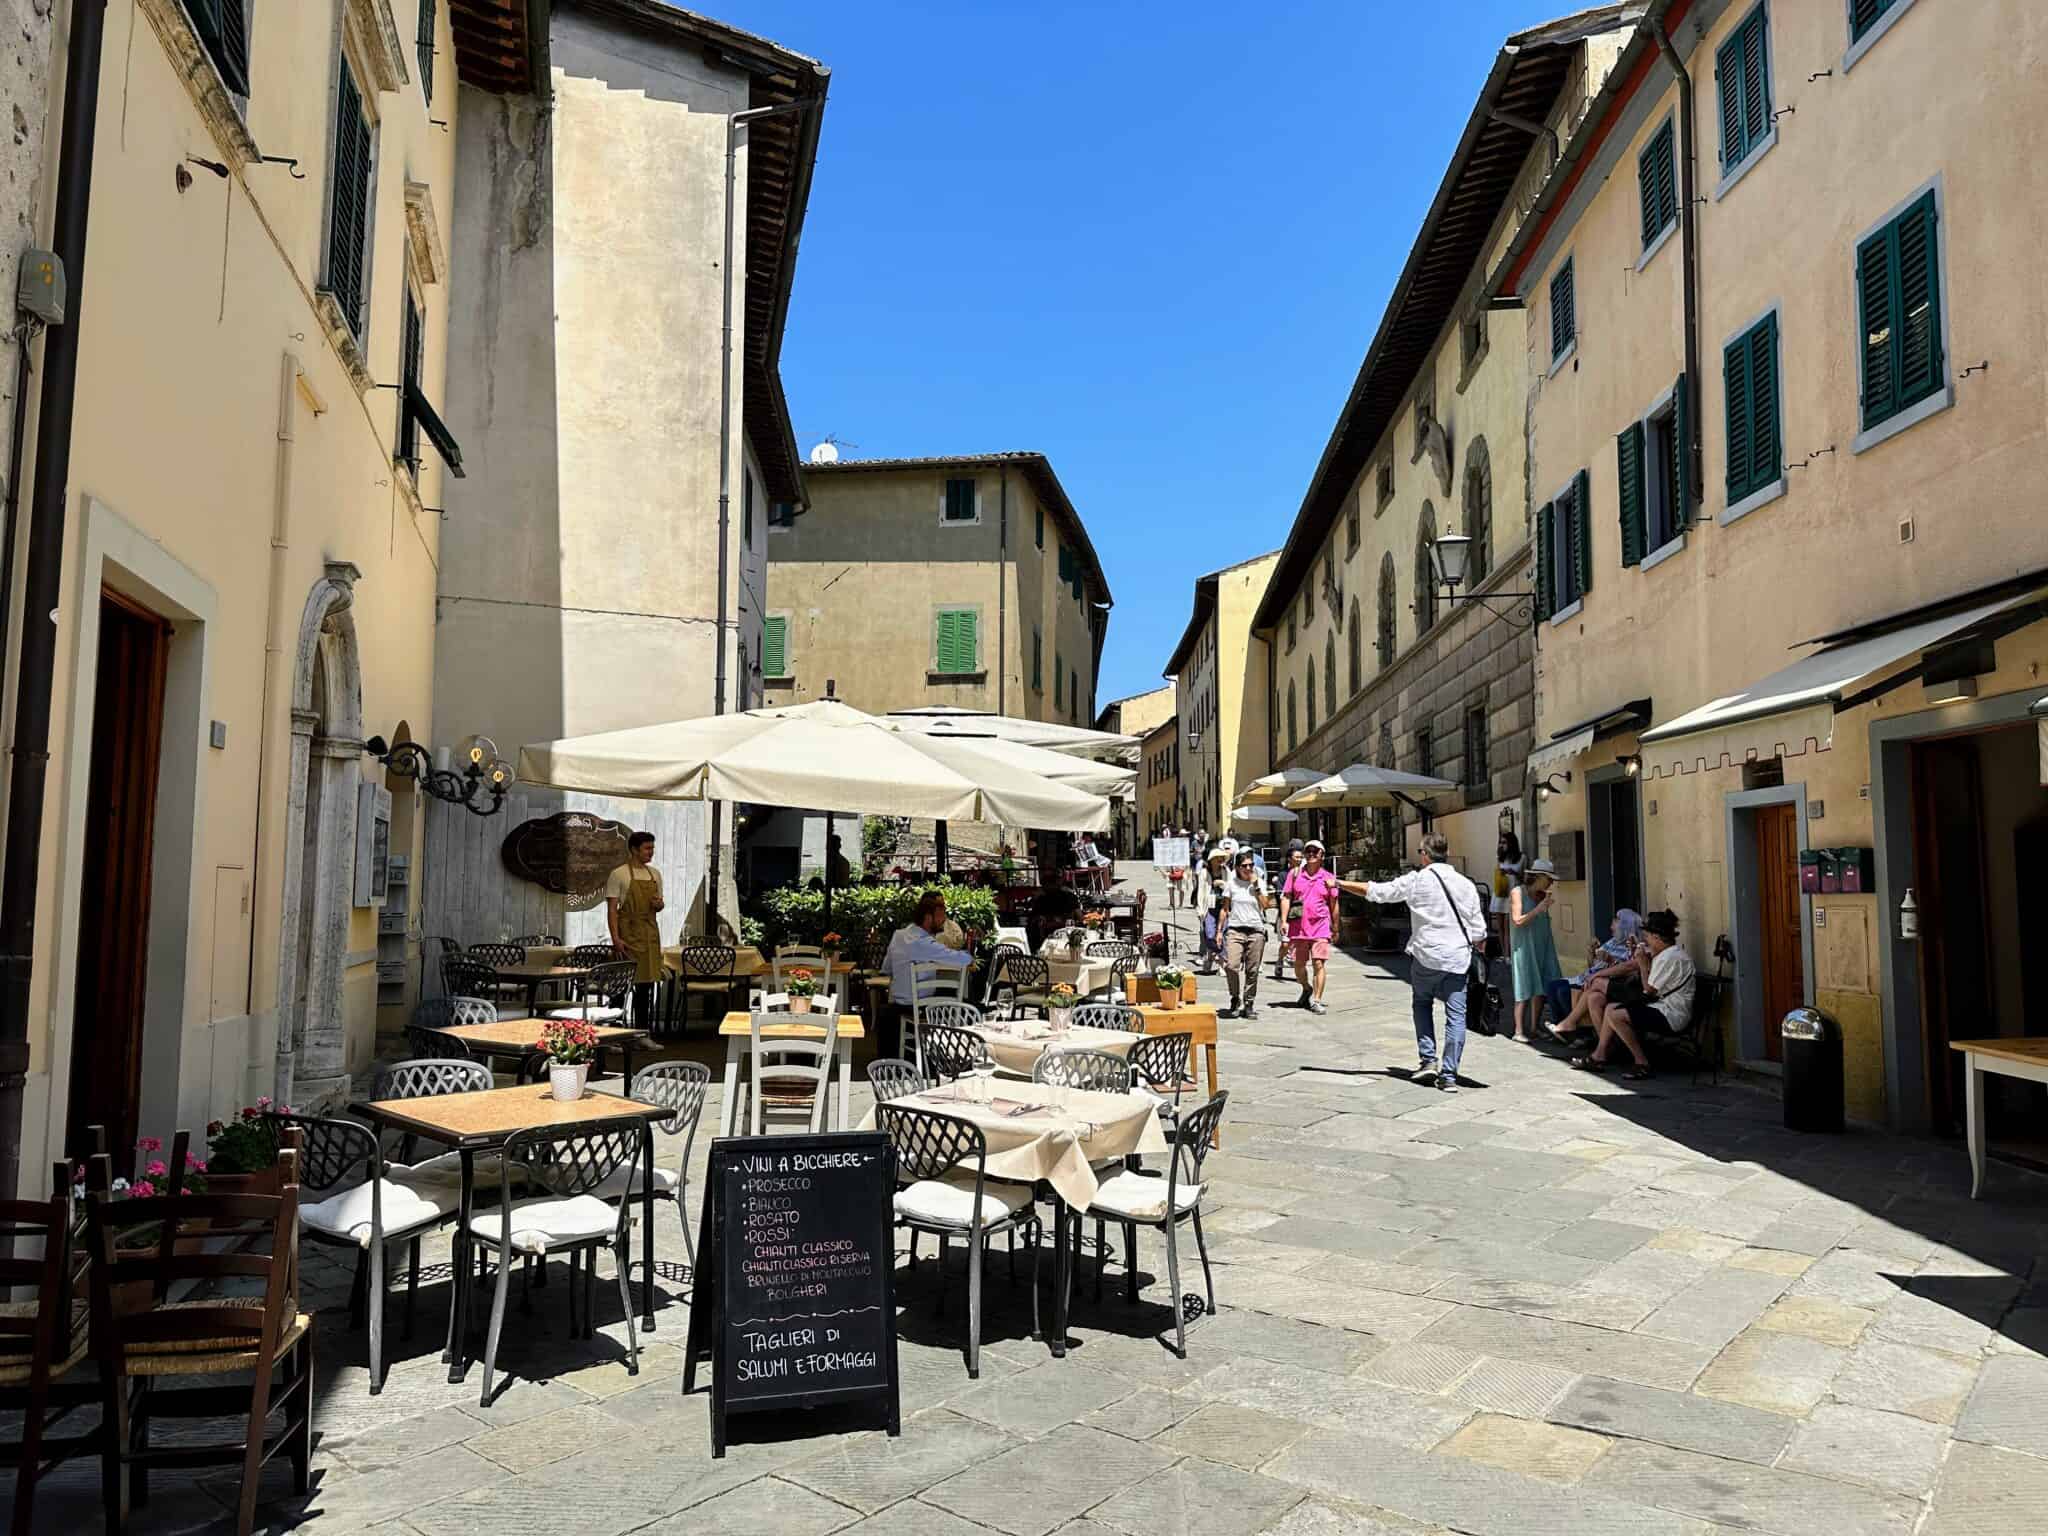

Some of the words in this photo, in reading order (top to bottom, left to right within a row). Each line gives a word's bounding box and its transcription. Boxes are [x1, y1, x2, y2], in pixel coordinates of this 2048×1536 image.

[742, 1155, 773, 1173] VINI
[777, 1156, 789, 1173] A
[793, 1153, 862, 1171] BICCHIERE
[748, 1178, 811, 1193] PROSECCO
[748, 1197, 792, 1212] BIANCO
[748, 1210, 800, 1227] ROSATO
[754, 1245, 798, 1258] CHIANTI
[801, 1240, 854, 1255] CLASSICO
[742, 1260, 781, 1273] CHIANTI
[782, 1257, 827, 1270] CLASSICO
[829, 1251, 871, 1265] RISERVA
[742, 1328, 816, 1353] TAGLIERI
[825, 1329, 840, 1341] DI
[736, 1357, 788, 1381] SALUMI
[794, 1359, 807, 1375] E
[806, 1351, 876, 1373] FORMAGGI
